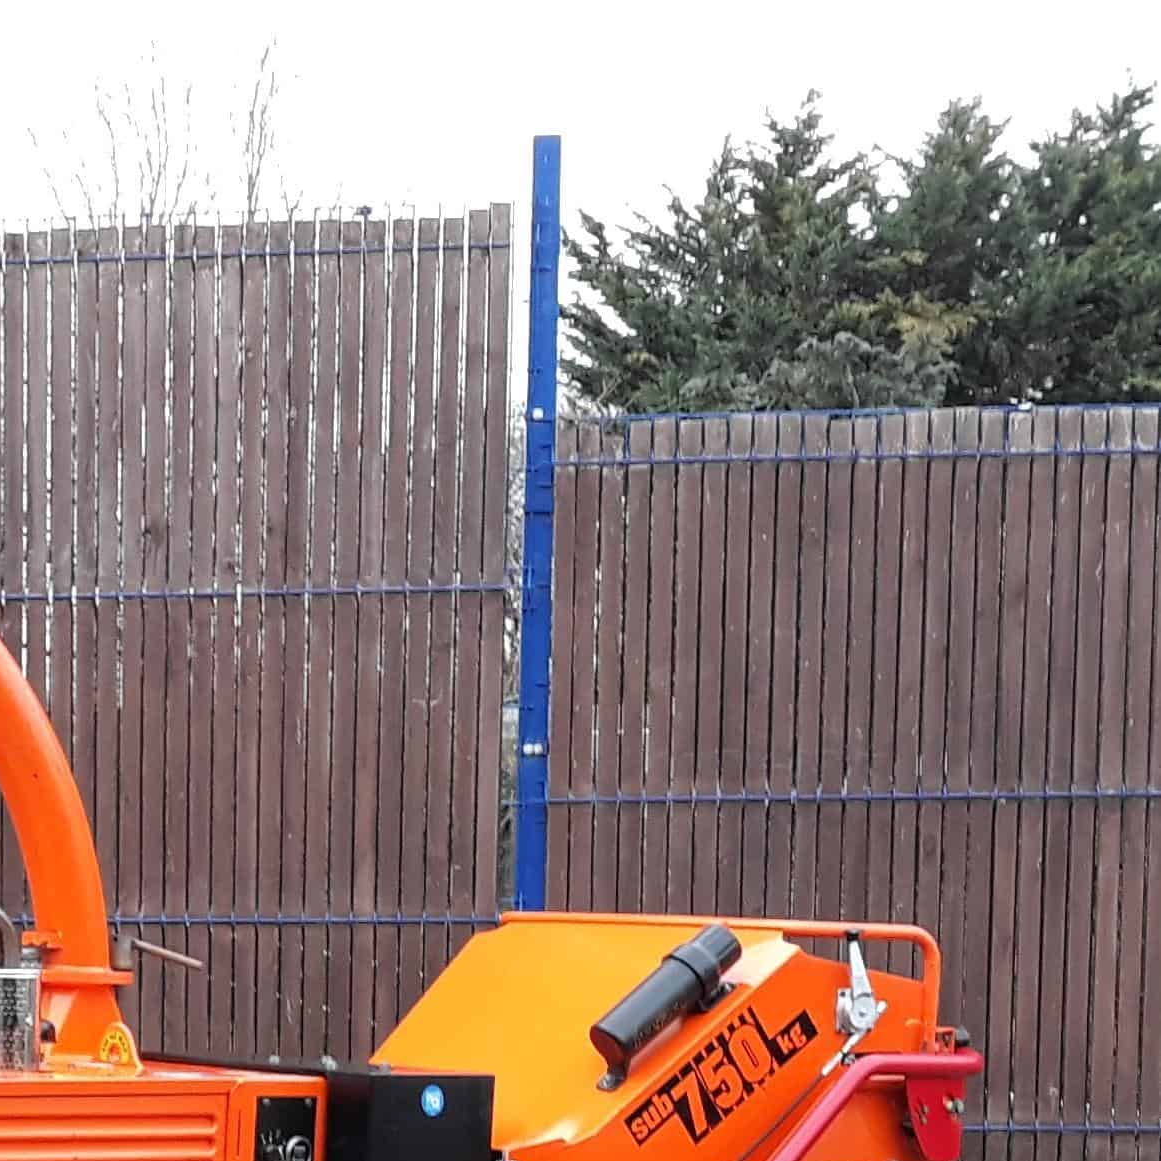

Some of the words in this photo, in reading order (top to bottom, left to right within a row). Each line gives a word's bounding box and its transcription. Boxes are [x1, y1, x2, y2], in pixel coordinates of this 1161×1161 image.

[630, 1093, 674, 1141] sub
[671, 1023, 773, 1138] 750
[775, 1020, 808, 1055] kg
